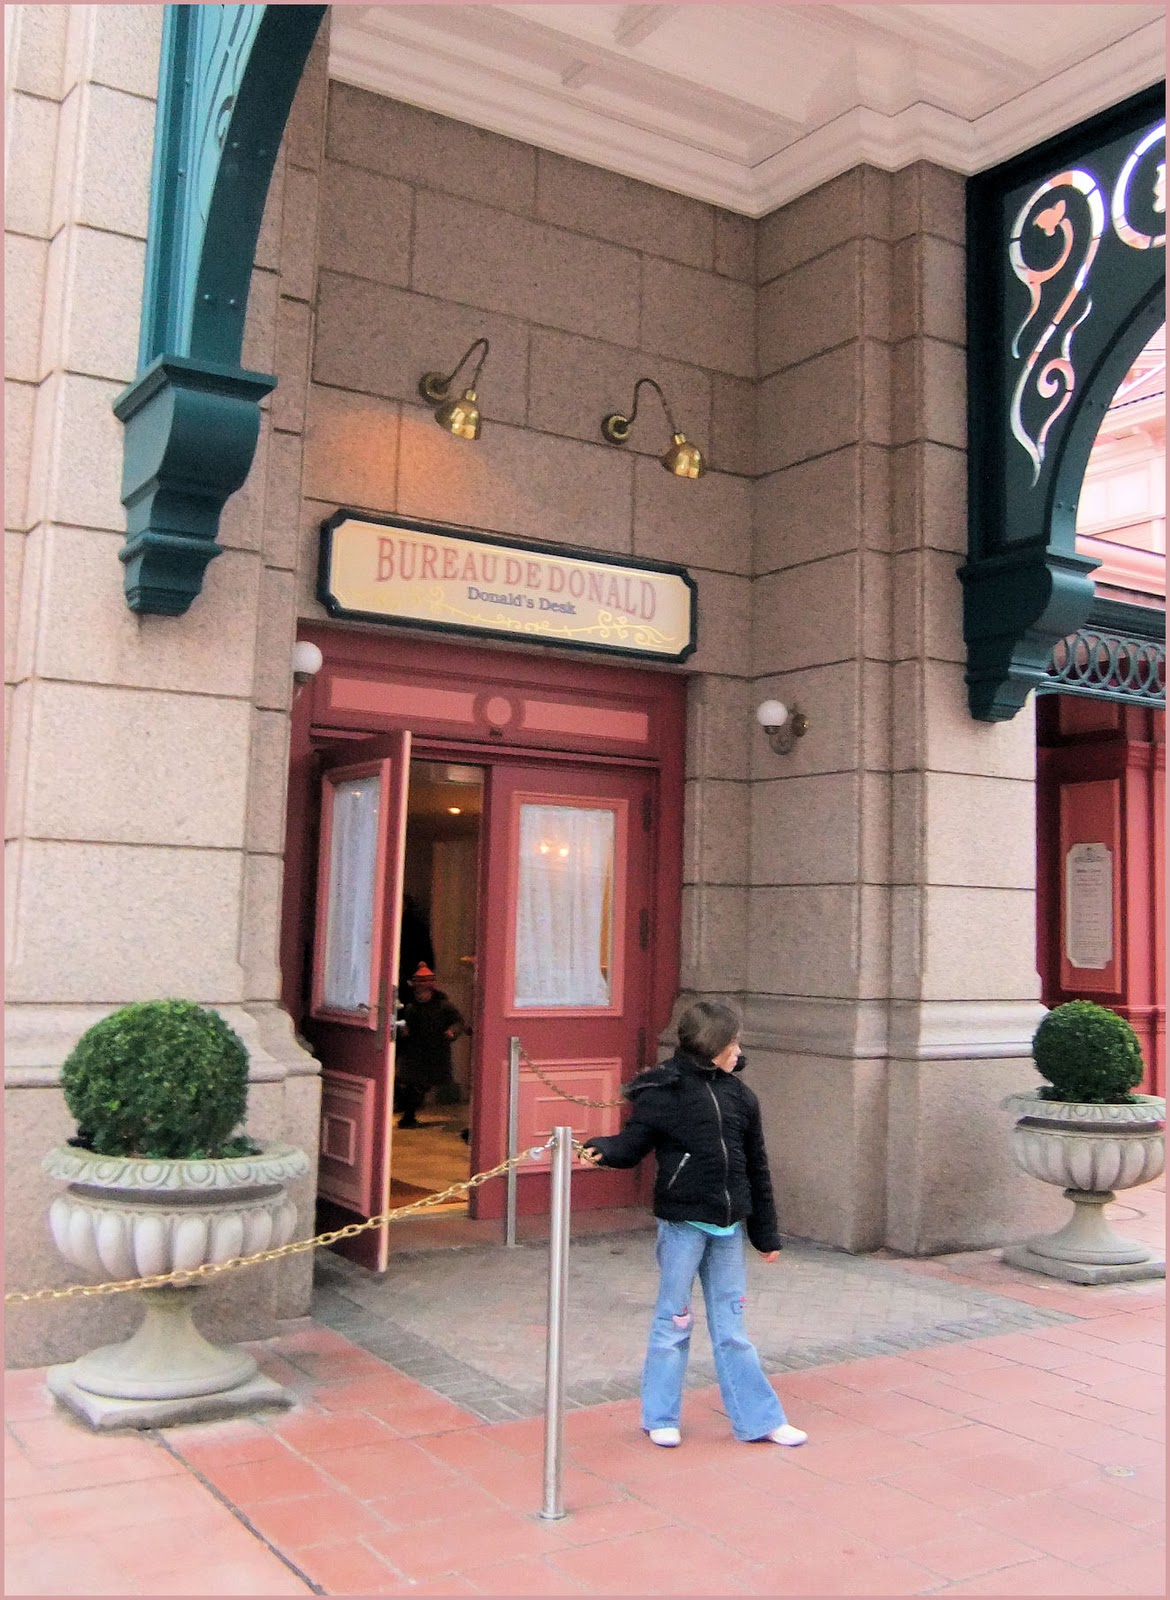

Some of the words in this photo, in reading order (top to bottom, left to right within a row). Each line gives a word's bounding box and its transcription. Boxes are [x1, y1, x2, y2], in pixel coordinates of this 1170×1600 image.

[376, 537, 498, 583] BUREAU
[505, 557, 541, 588] DE
[547, 564, 657, 621] DONALD
[467, 586, 535, 609] Donald's
[539, 597, 577, 615] Desk
